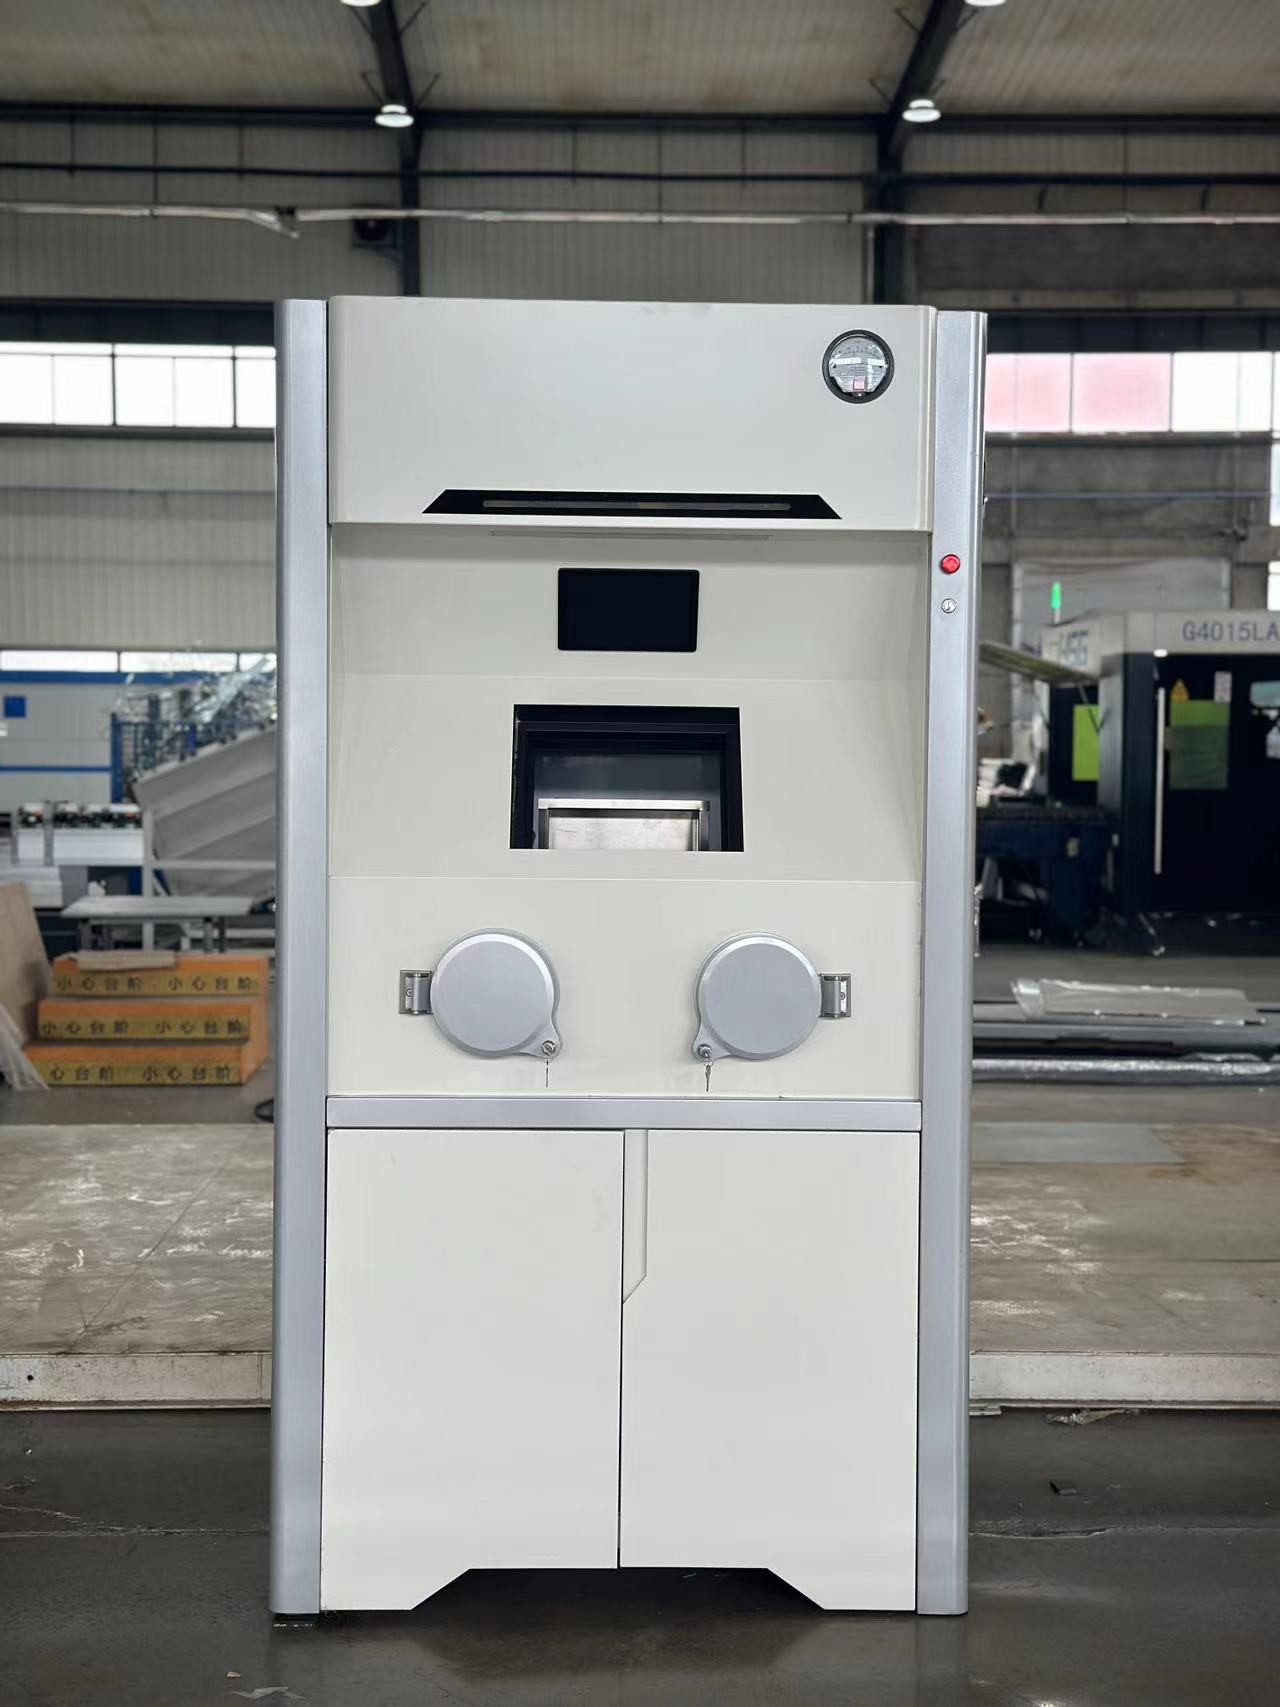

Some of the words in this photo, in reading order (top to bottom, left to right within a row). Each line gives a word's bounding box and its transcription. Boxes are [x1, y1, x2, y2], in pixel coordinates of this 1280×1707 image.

[1182, 620, 1280, 641] G4015LA
[57, 976, 143, 991] 小心台阶
[168, 976, 253, 991] 小心台阶
[42, 1020, 129, 1034] 小心台阶
[156, 1019, 243, 1035] 小心台阶
[142, 1063, 231, 1081] 小心台阶
